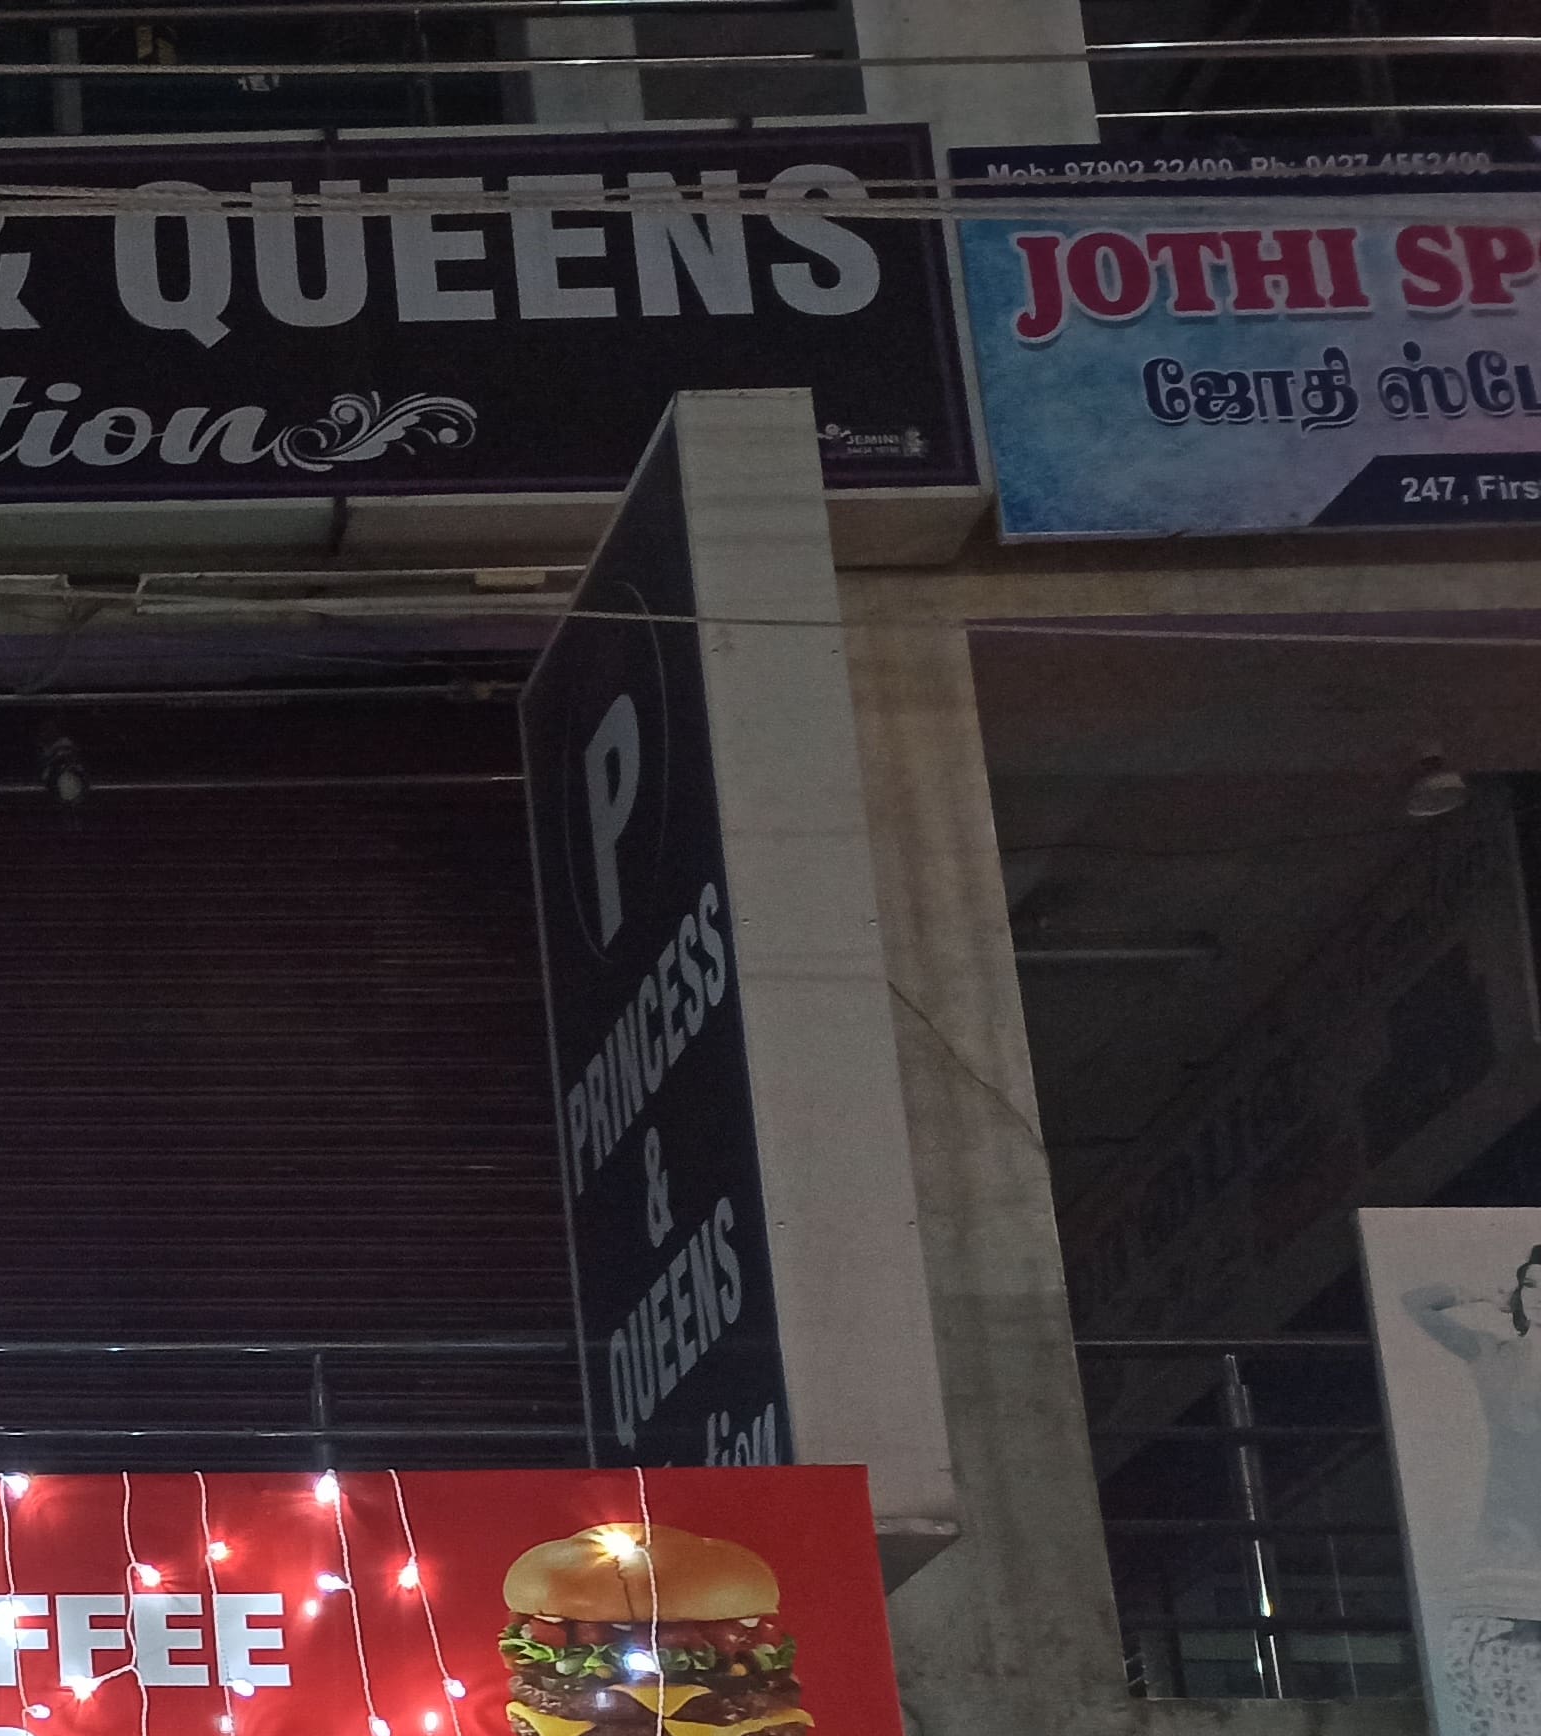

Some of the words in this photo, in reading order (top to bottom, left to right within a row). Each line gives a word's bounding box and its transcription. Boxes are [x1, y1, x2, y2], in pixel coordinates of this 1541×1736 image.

[116, 164, 881, 348] QUEENS
[1014, 226, 1372, 342] JOTHI
[1395, 223, 1541, 315] SP
[1143, 346, 1358, 432] ஜோதி
[1401, 476, 1468, 504] 247,
[584, 693, 641, 953] P
[566, 882, 727, 1197] PRINCESS
[642, 1126, 675, 1249] &
[608, 1197, 743, 1450] QUEENS
